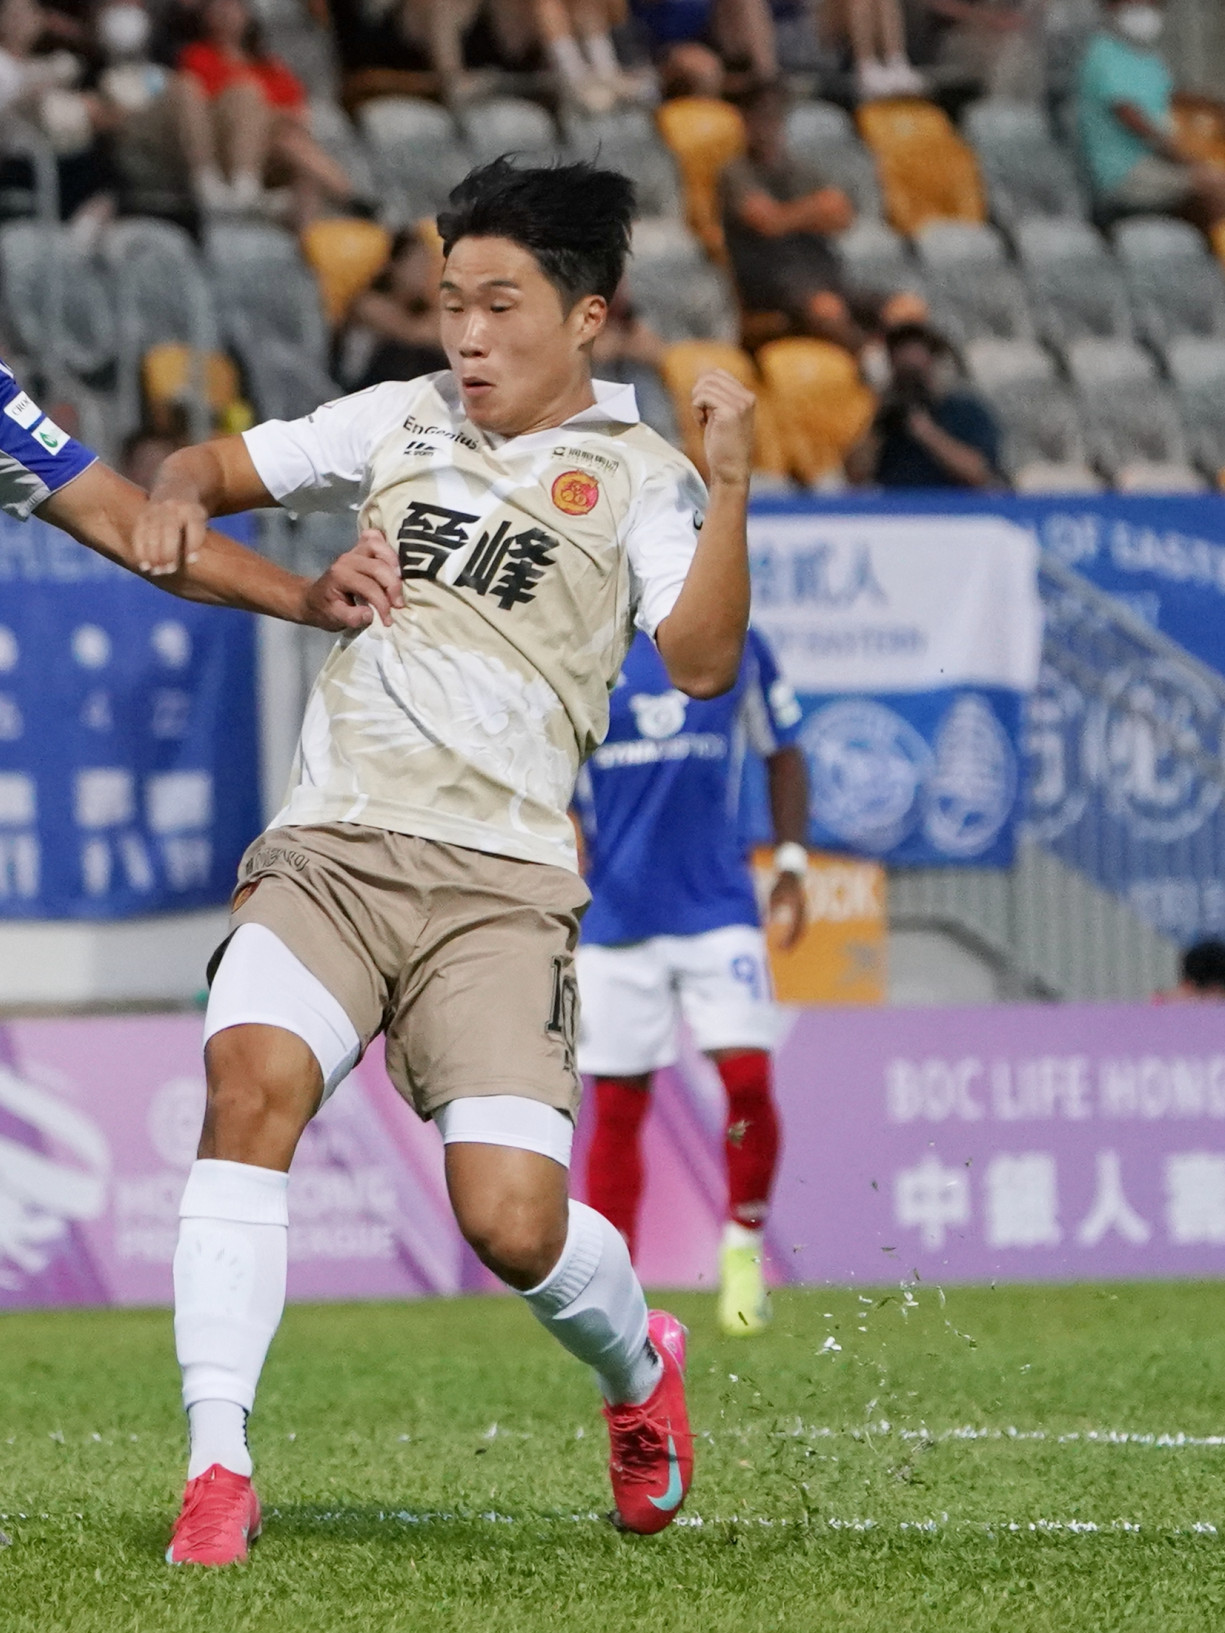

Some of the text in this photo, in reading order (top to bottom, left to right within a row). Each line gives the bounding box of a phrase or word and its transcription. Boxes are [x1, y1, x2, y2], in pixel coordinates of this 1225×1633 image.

[403, 414, 479, 451] EnGenius
[397, 500, 560, 612] 晉峰
[886, 1057, 984, 1121] BOC
[990, 1056, 1091, 1120] LIFE
